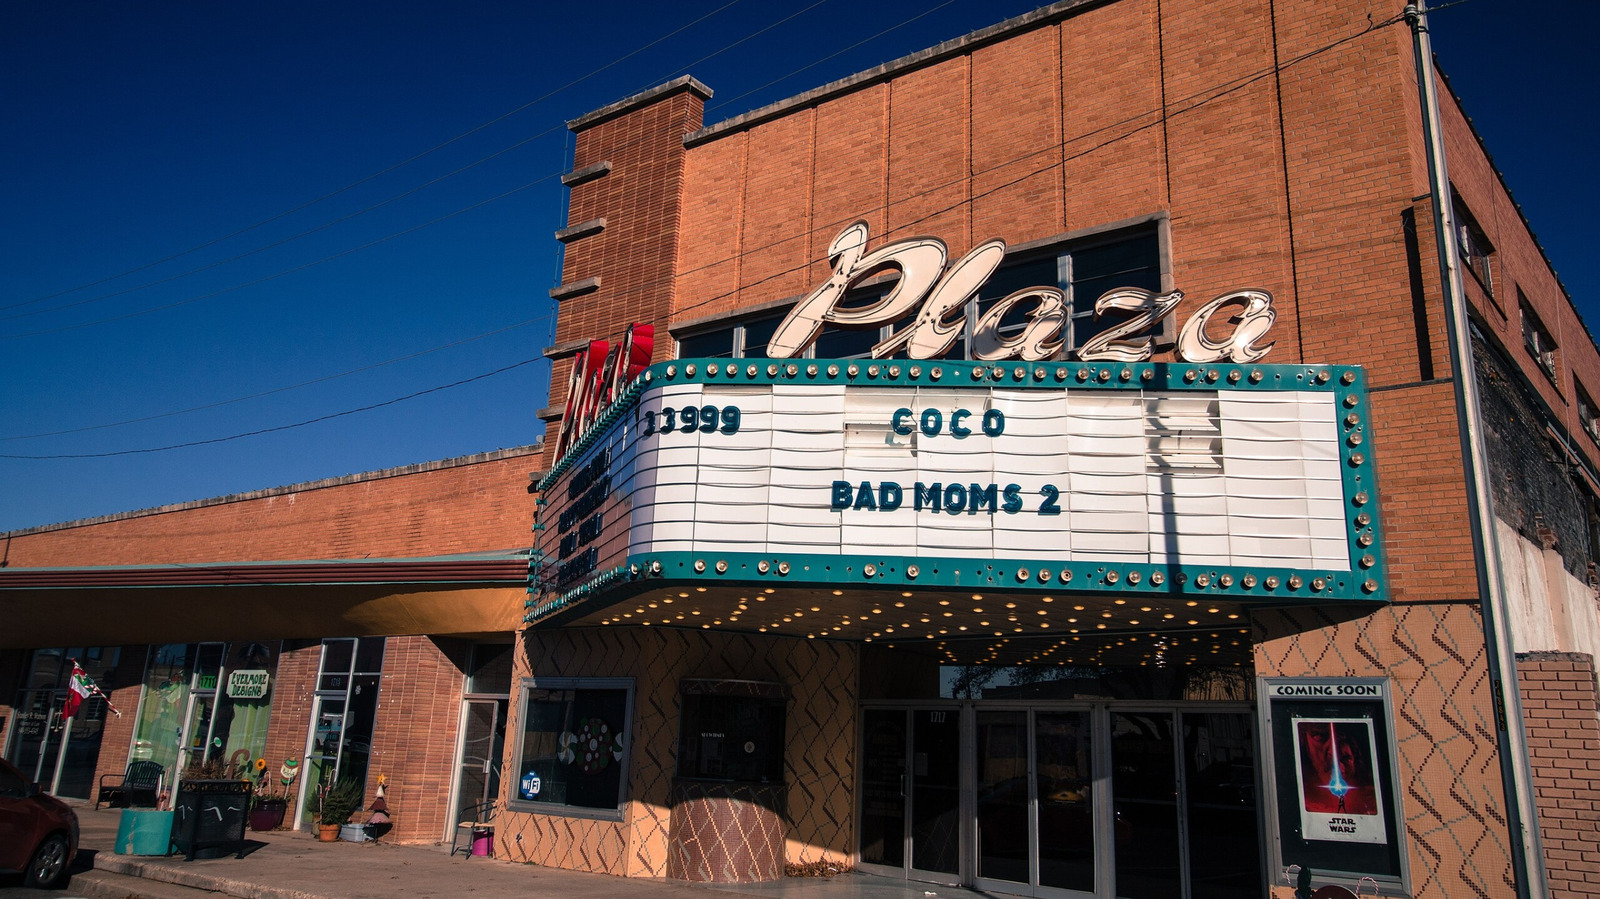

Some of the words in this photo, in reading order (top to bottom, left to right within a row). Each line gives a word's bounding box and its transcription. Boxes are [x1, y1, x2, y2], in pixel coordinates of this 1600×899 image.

[766, 218, 1276, 362] Plaza
[892, 407, 1006, 439] COCO
[831, 480, 903, 512] BAD
[914, 482, 1023, 515] MOMS
[1038, 483, 1062, 515] 2
[231, 673, 267, 685] EVERMORE
[232, 685, 262, 697] DESIGNS
[1277, 686, 1332, 695] COMING
[1337, 685, 1377, 695] SOON
[930, 711, 947, 723] 1717
[1328, 817, 1356, 825] STAR
[1329, 825, 1356, 833] WARS
